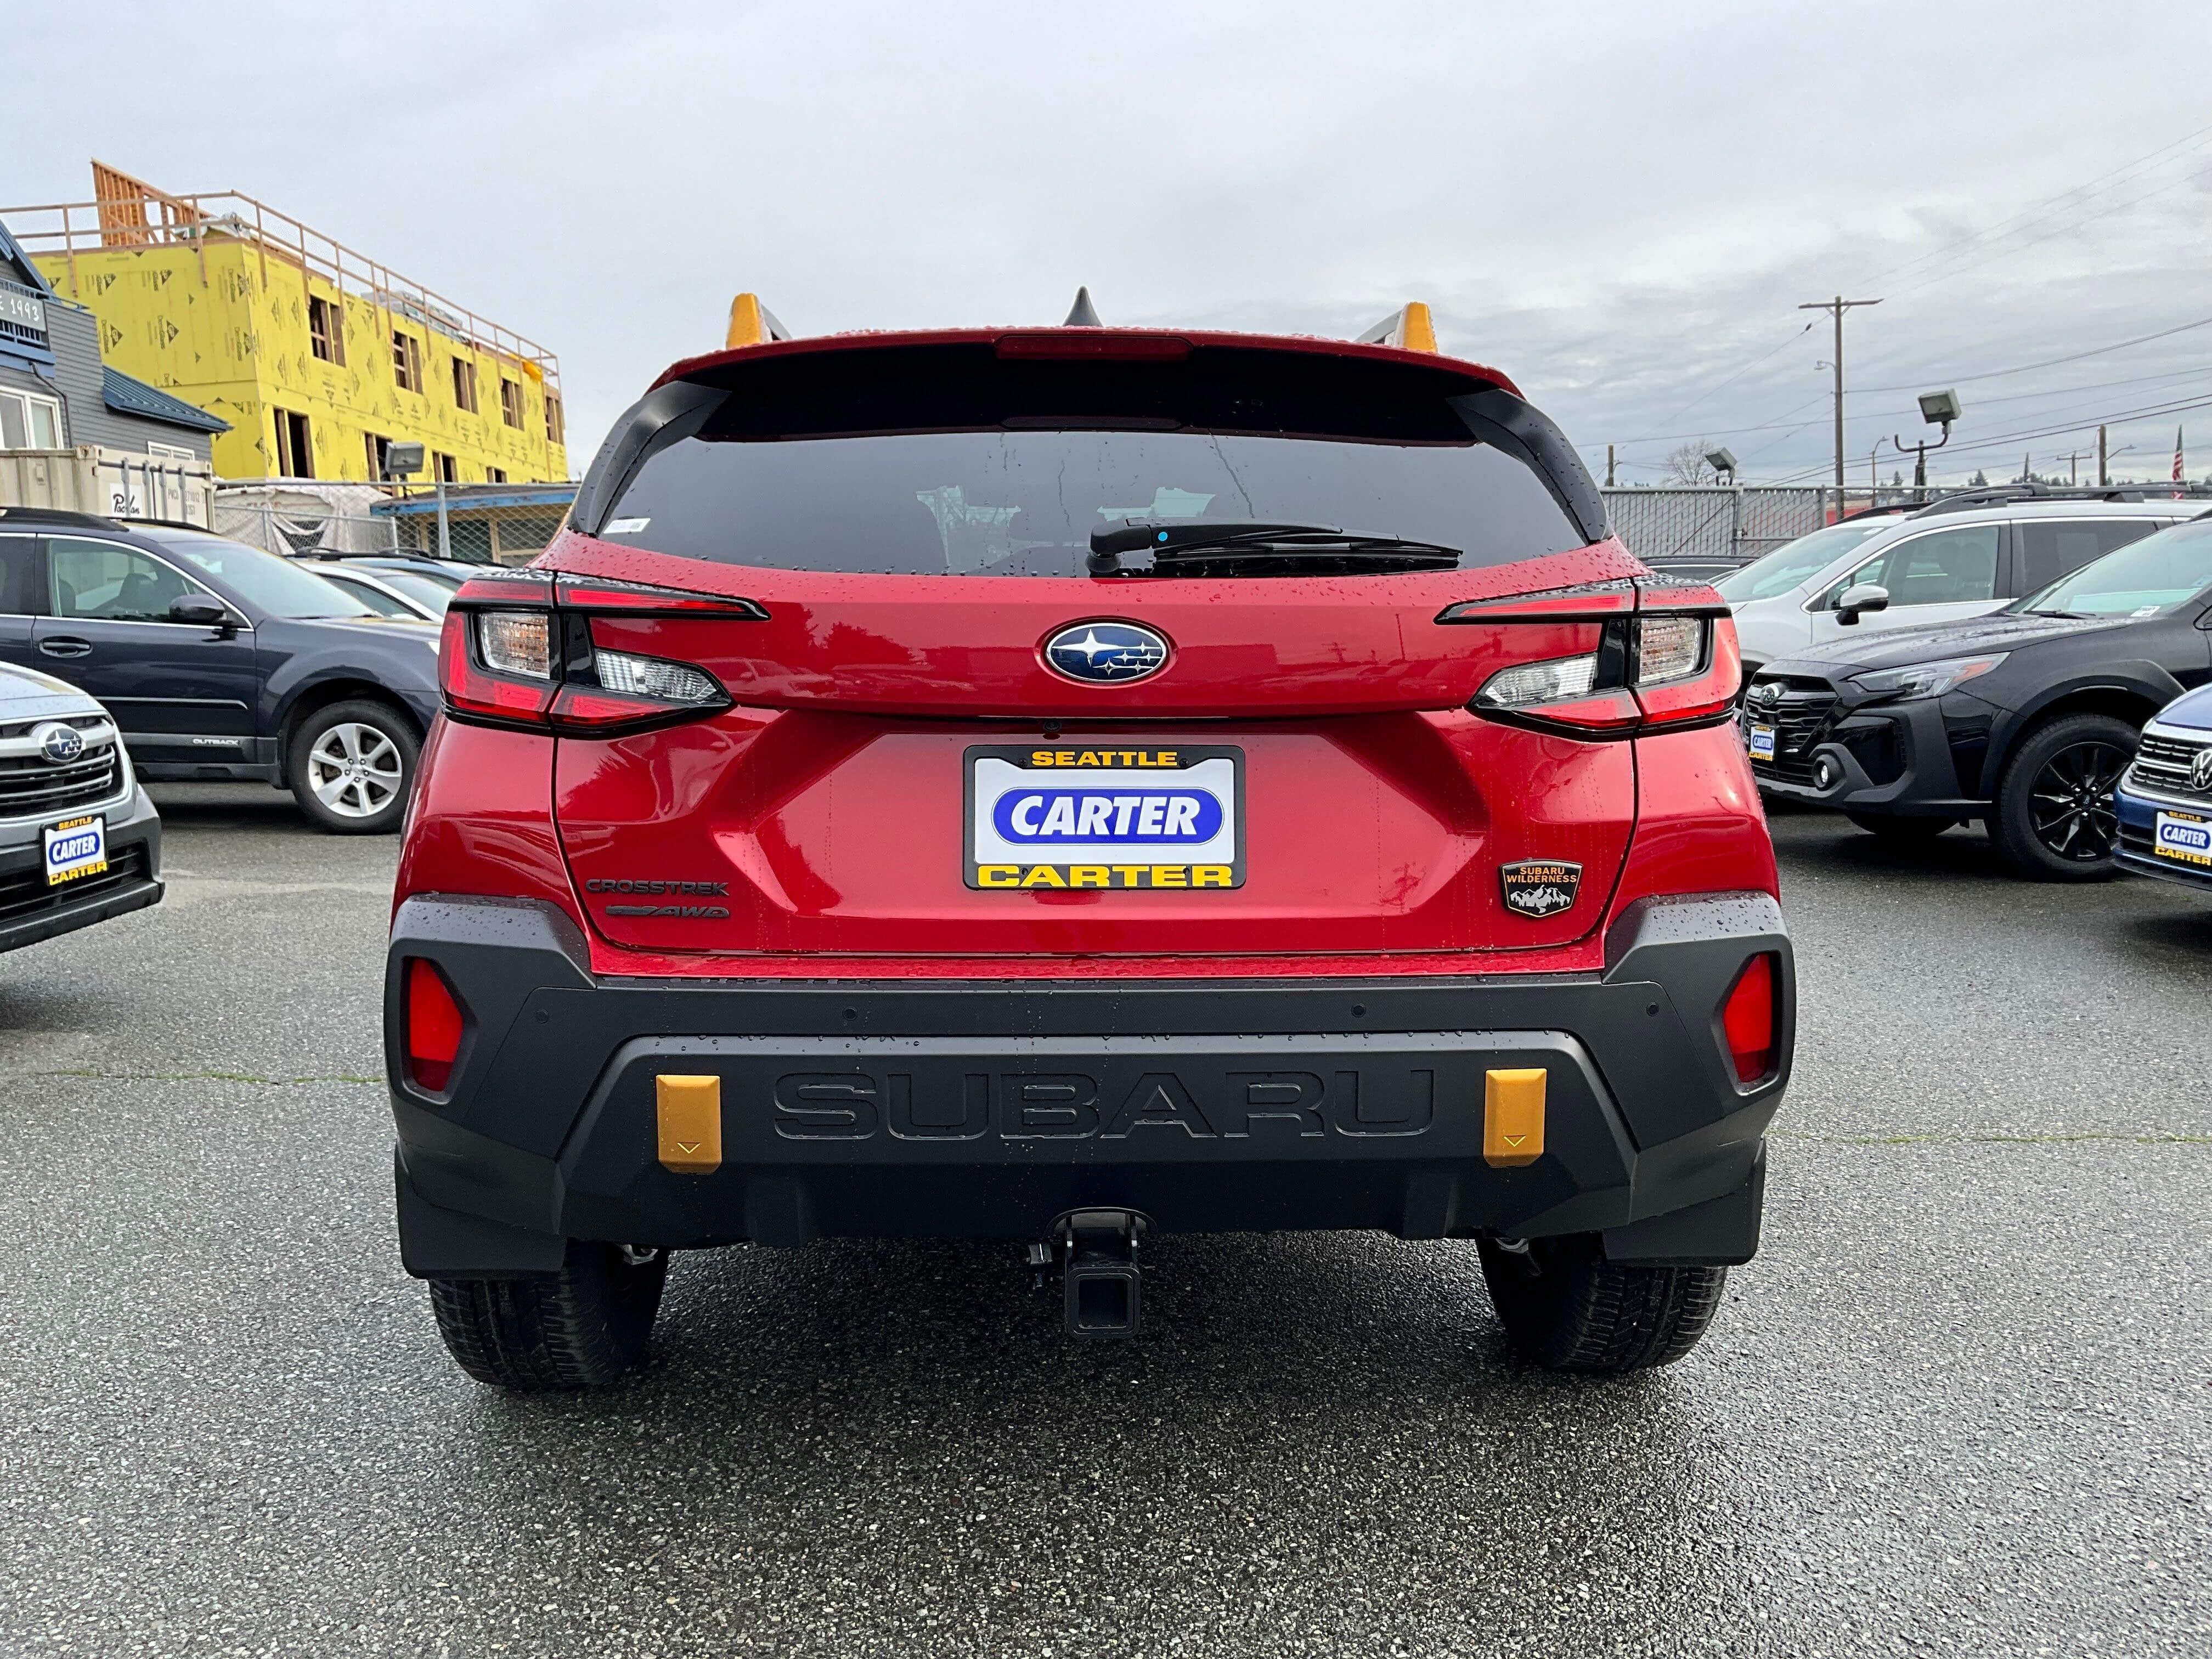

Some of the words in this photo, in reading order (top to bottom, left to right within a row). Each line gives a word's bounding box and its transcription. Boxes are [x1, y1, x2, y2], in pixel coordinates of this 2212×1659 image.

[10, 298, 40, 321] 1993
[1754, 736, 1772, 748] CARTER
[1031, 751, 1178, 766] SEATTLE
[1749, 751, 1773, 761] CARTER
[58, 816, 92, 830] SEATTLE
[1011, 795, 1201, 836] CARTER
[2168, 811, 2202, 822] SEATTLE
[2163, 826, 2207, 847] CARTER
[52, 834, 96, 862] CARTER
[2154, 847, 2212, 866] CARTER
[49, 860, 108, 885] CARTER
[977, 865, 1233, 887] CARTER
[1506, 874, 1577, 883] WILDERNESS
[1520, 867, 1565, 875] SUBARU
[585, 879, 730, 896] CROSSTREK
[654, 906, 730, 918] AWD
[772, 1069, 1434, 1141] SUBARU
